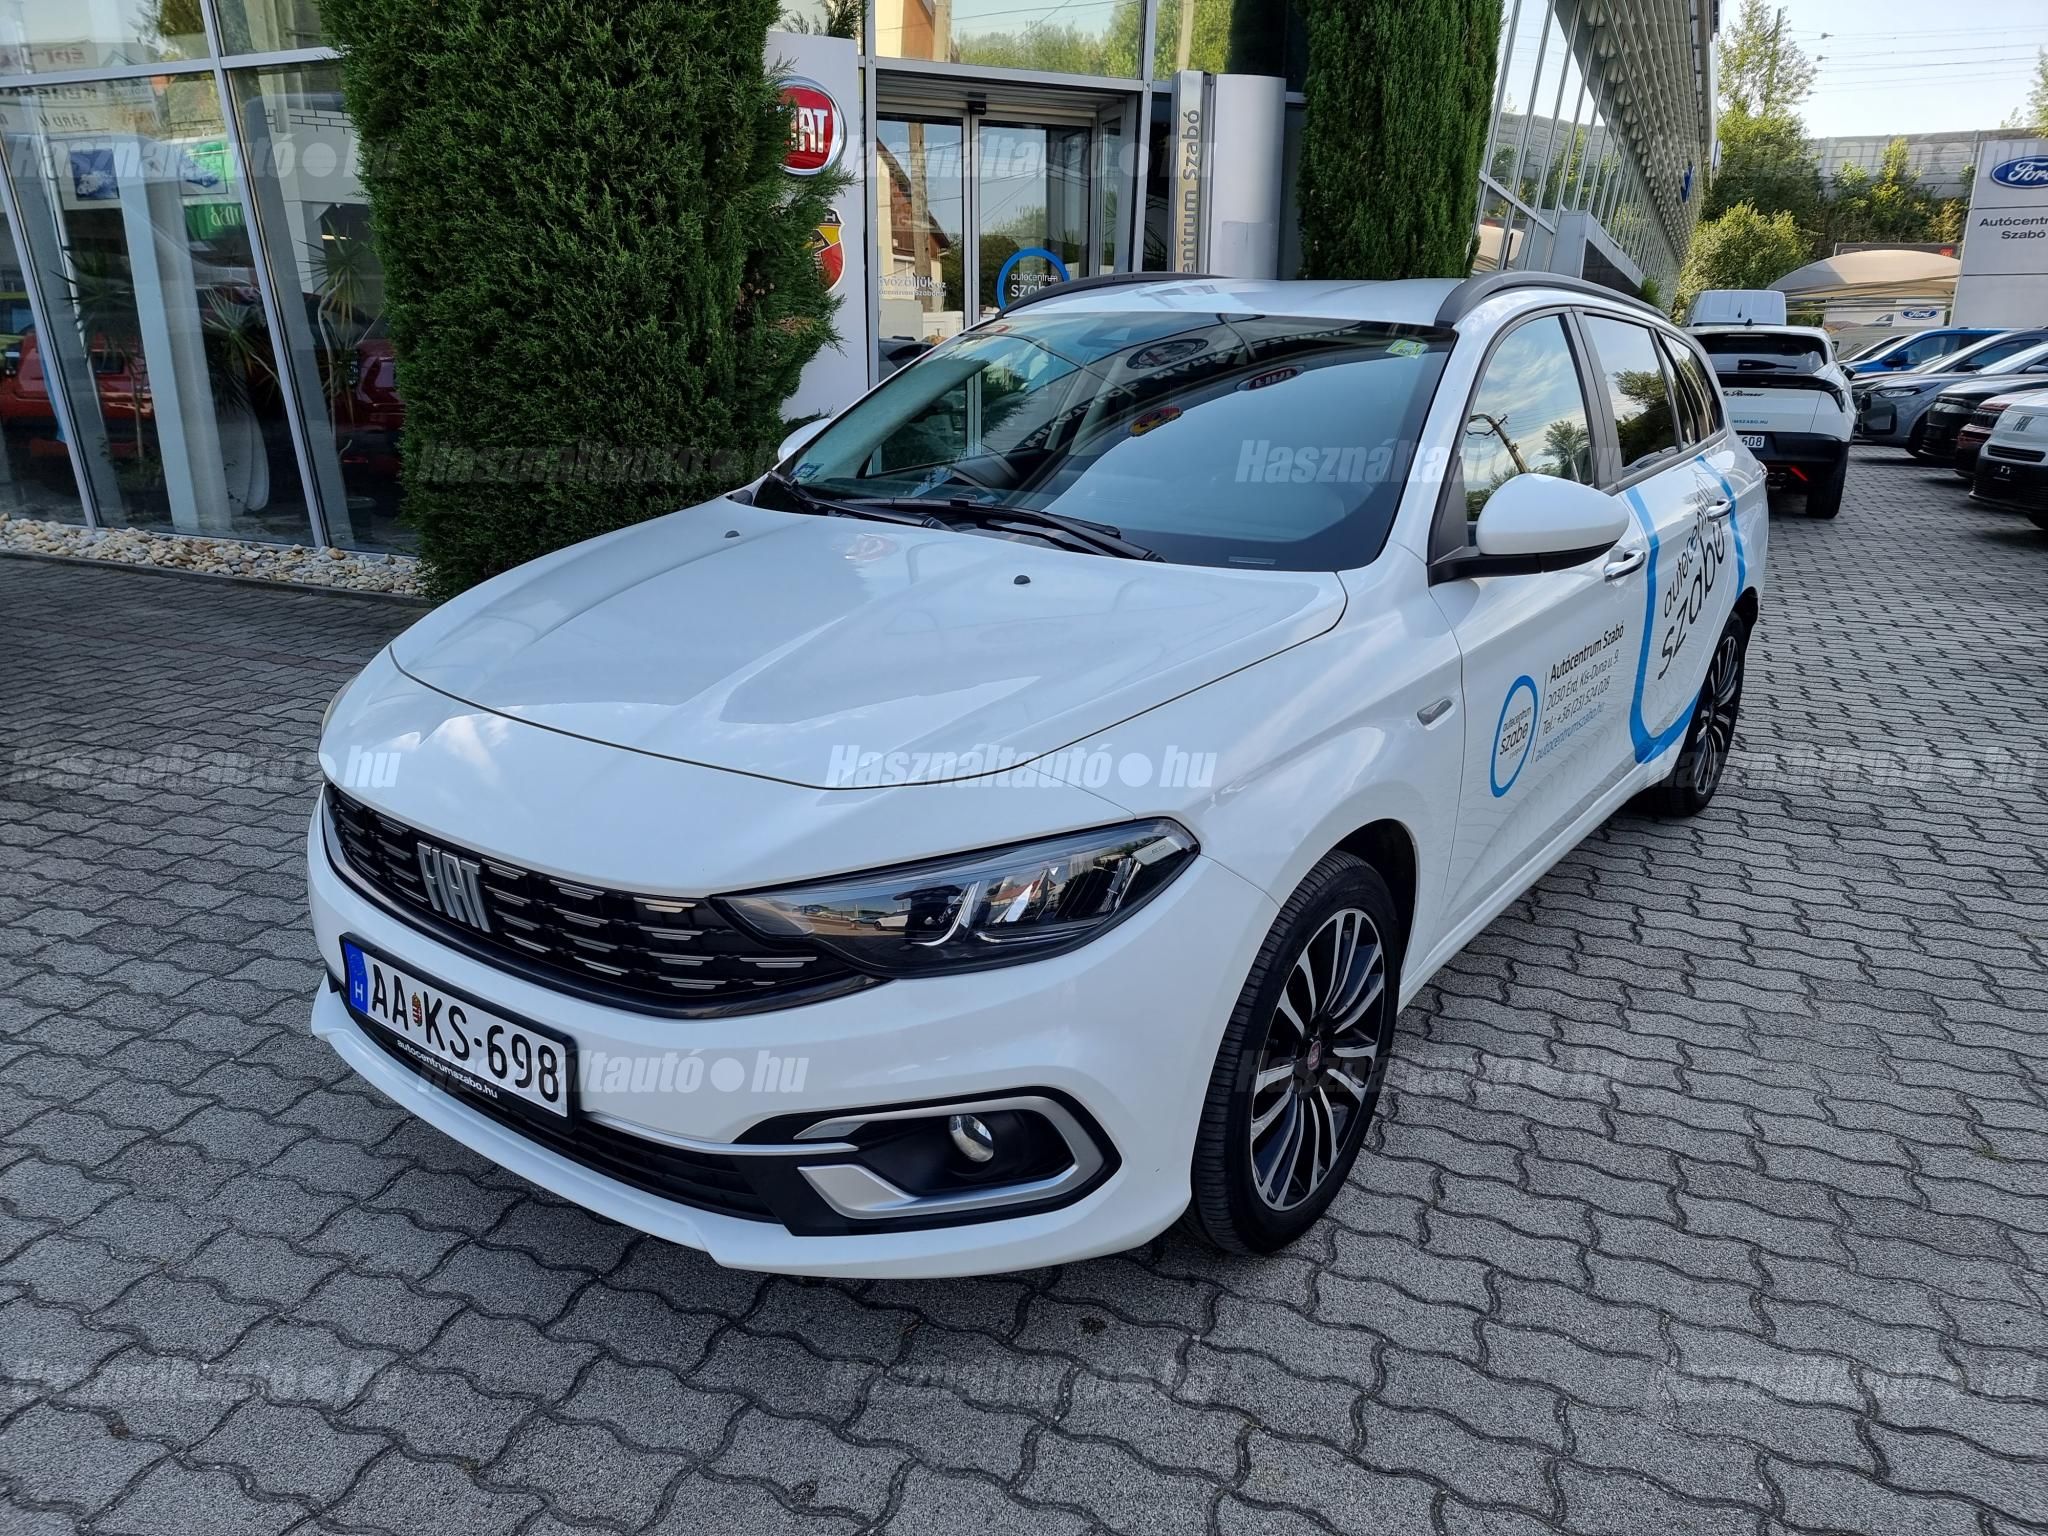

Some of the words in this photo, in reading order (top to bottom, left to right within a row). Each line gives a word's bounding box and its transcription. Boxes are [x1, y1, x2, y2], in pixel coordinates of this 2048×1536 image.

[789, 107, 828, 154] IAT
[1182, 109, 1200, 181] Szabó
[1181, 190, 1197, 273] entrum
[1980, 216, 2048, 227] Autócentr
[2001, 229, 2046, 240] Szabó
[1550, 639, 1602, 684] Autócentrum
[1602, 619, 1625, 649] Szabó
[1546, 685, 1566, 711] 2030
[417, 841, 491, 933] FIAT
[353, 983, 364, 1002] H
[397, 1039, 498, 1099] autocentrumszabo.hu
